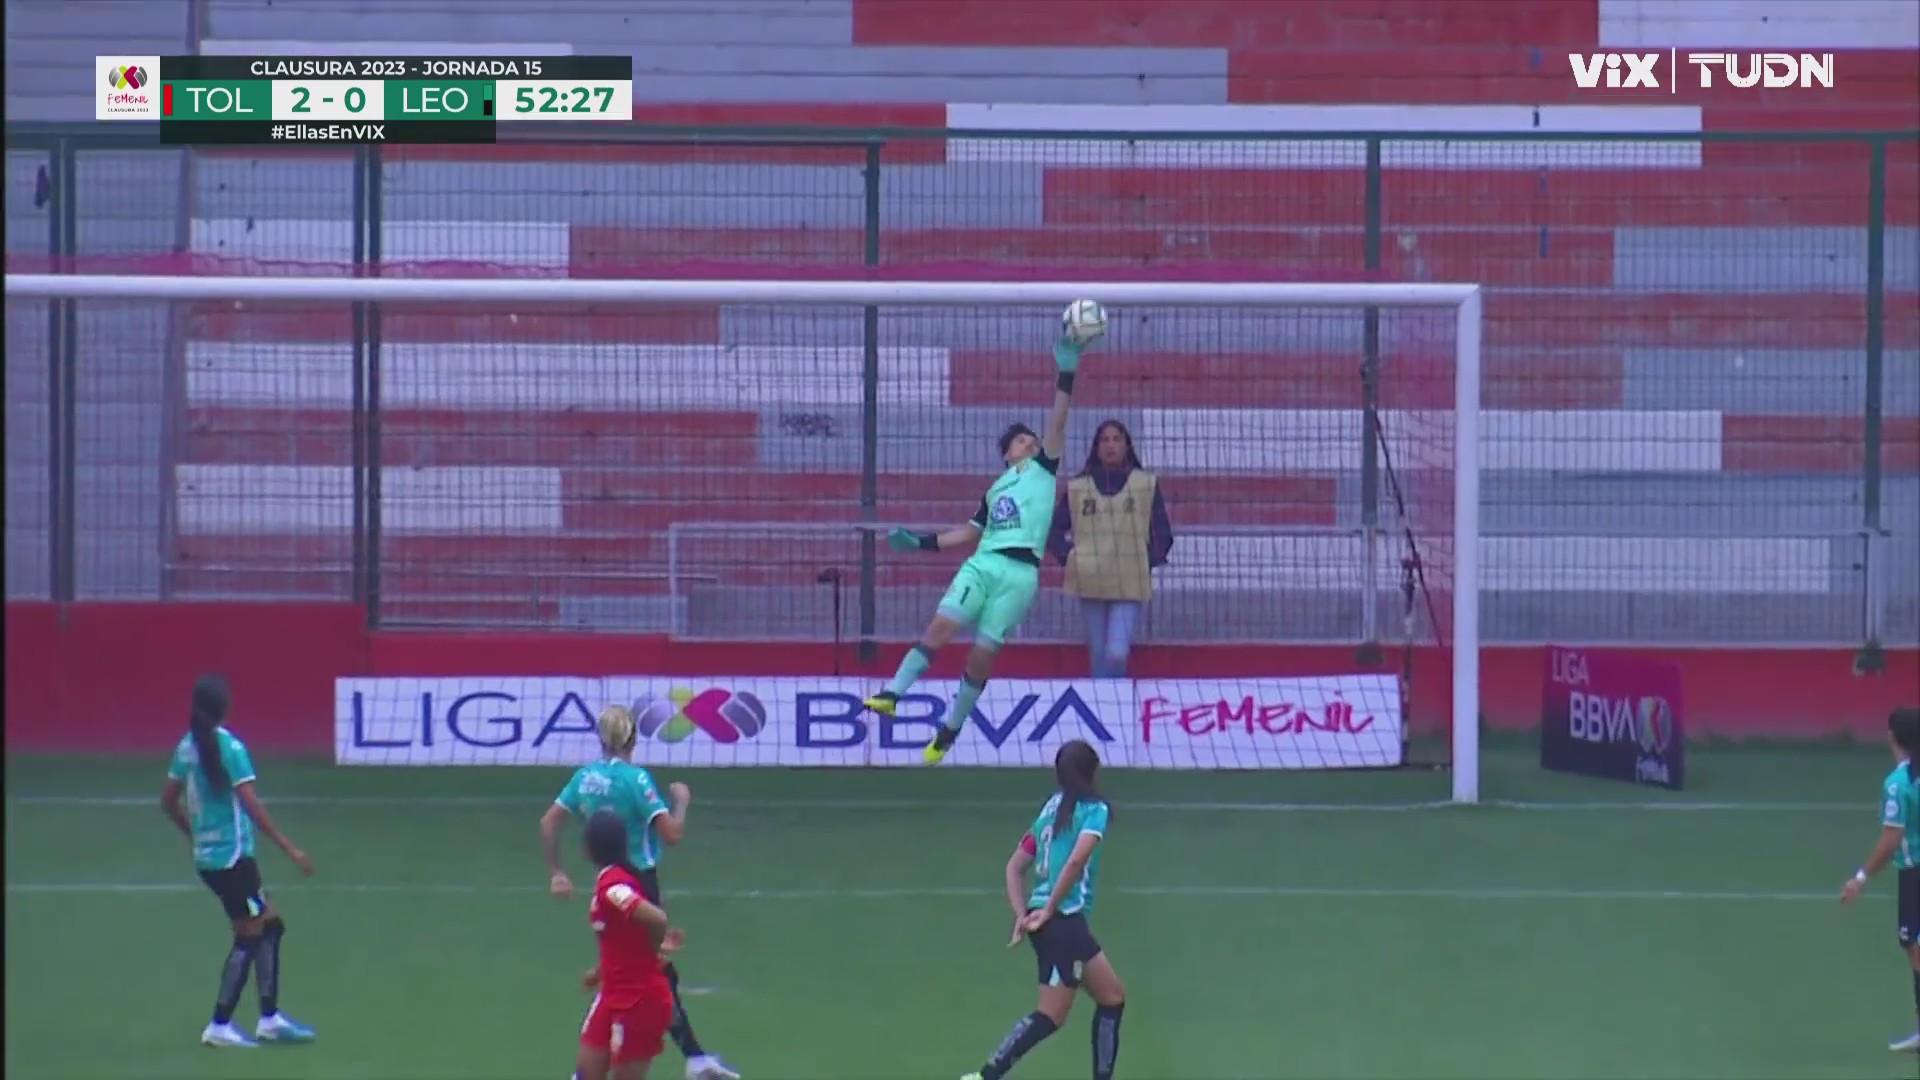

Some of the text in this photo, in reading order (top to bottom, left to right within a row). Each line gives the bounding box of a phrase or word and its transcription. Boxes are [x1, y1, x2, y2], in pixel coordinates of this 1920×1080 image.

[1552, 649, 1590, 686] LIGA
[352, 691, 597, 748] LIGA
[796, 685, 1116, 749] BBVA
[1571, 689, 1637, 743] BBVA
